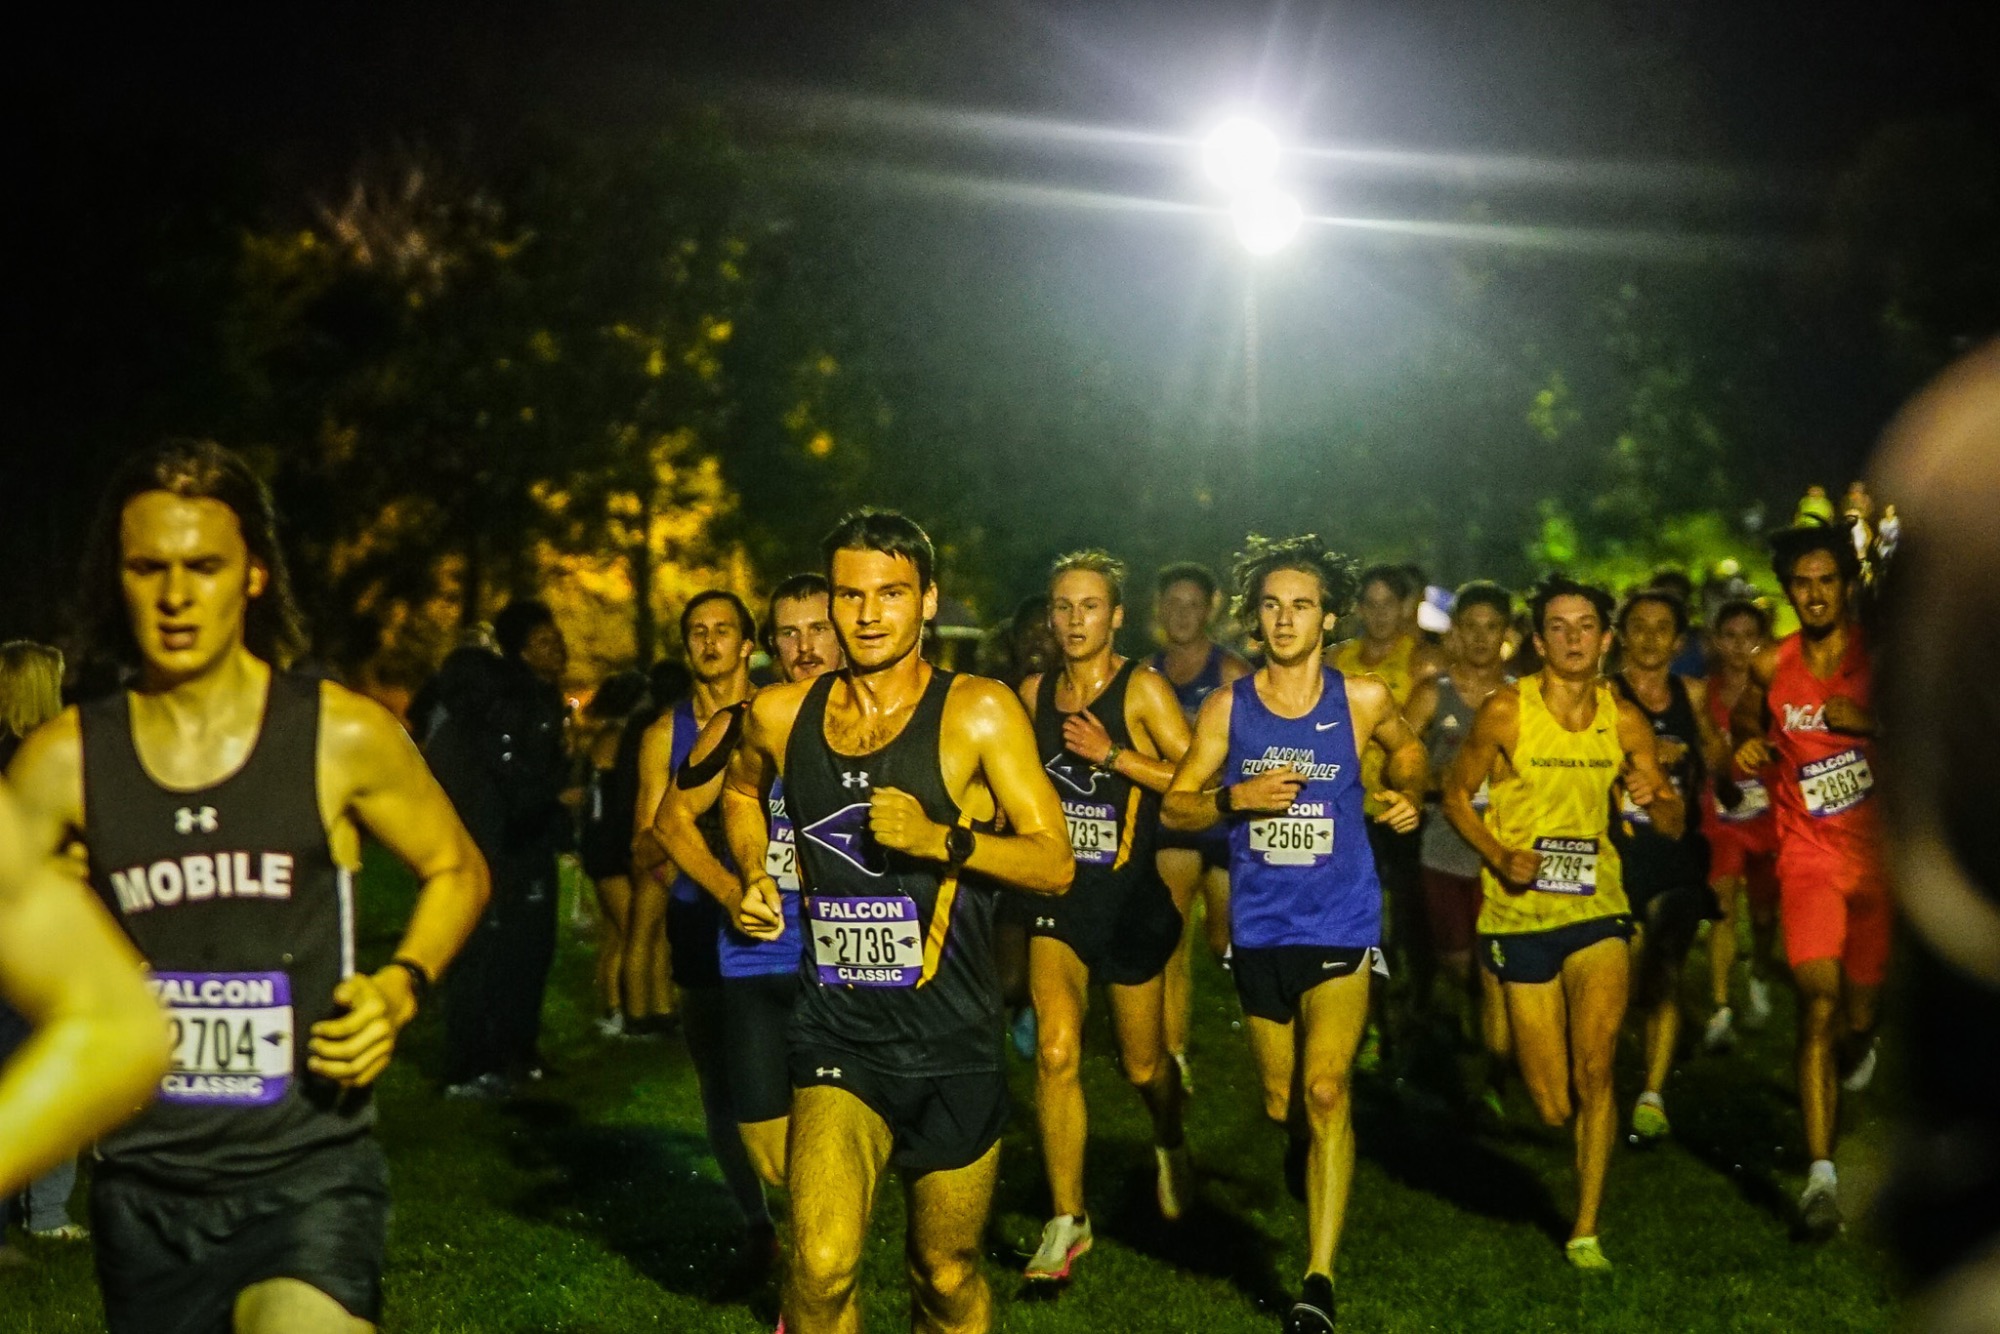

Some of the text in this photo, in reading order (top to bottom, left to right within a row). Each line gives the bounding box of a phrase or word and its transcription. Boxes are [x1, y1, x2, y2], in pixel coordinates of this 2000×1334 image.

[1262, 746, 1314, 763] ALABAMA
[1803, 749, 1856, 777] FALCON
[1818, 769, 1859, 803] 2863
[1061, 802, 1107, 817] LCON
[1288, 803, 1324, 816] CON
[1069, 821, 1099, 847] 733
[1267, 822, 1314, 849] 2566
[1541, 839, 1594, 852] FALCON
[1540, 855, 1583, 880] 2799
[110, 852, 293, 914] MOBILE
[818, 902, 904, 918] FALCON
[835, 927, 896, 963] 2736
[837, 968, 903, 982] CLASSIC
[166, 1017, 256, 1069] 2704
[161, 1074, 264, 1096] CLASSIC
